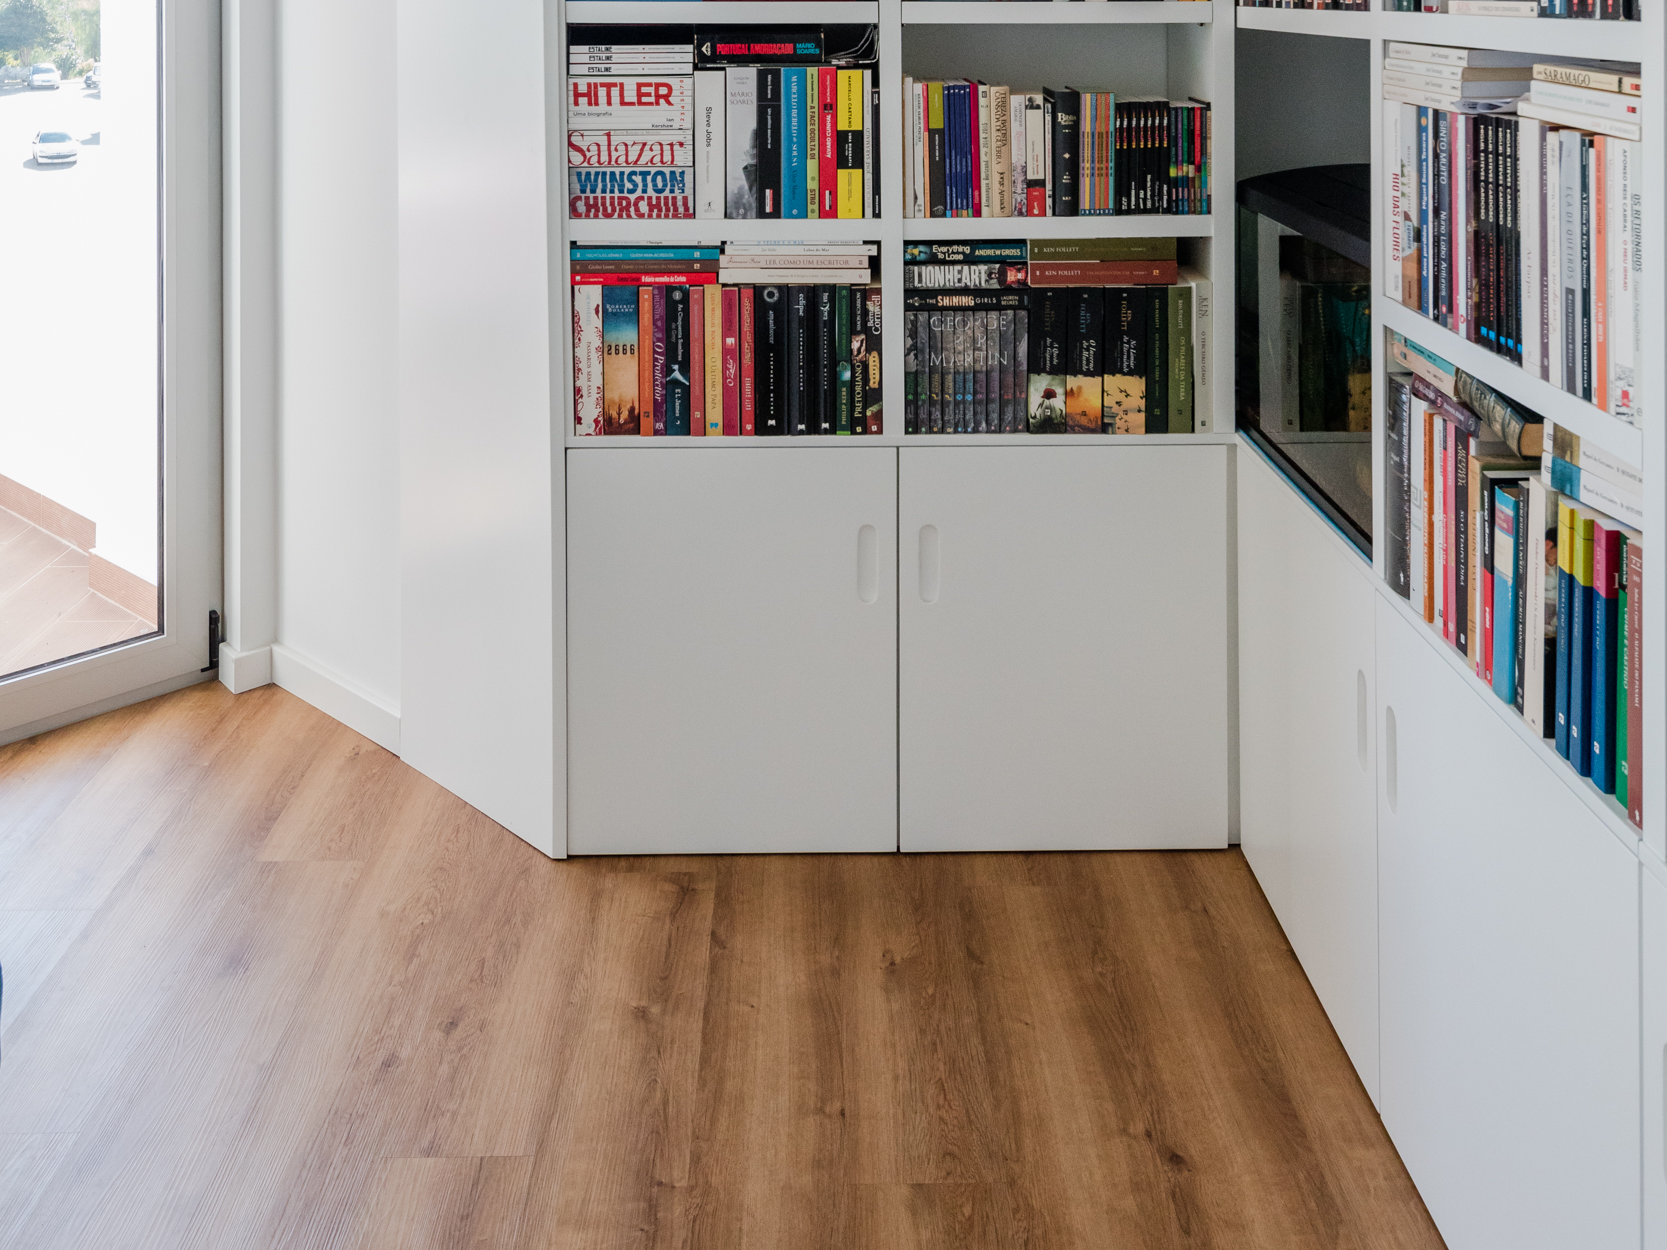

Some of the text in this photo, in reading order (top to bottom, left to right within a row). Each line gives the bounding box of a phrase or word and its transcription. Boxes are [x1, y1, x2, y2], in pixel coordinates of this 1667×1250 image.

[716, 43, 794, 55] PORTUGAL AMORDAÇADO
[1543, 68, 1590, 86] SARAMAGO
[572, 82, 674, 107] HITLER
[995, 125, 1001, 135] DE
[568, 131, 684, 166] Salazar
[576, 170, 686, 194] WINSTON
[997, 171, 1006, 189] Jorge
[570, 195, 694, 219] CHURCHILL
[1392, 172, 1400, 262] RIO DAS FLORES
[1633, 193, 1642, 272] OS RETORNADOS
[933, 245, 970, 254] Everything
[914, 266, 988, 287] LIONHEART
[794, 294, 806, 316] eclipse
[938, 296, 974, 307] SHINING
[872, 295, 881, 334] Cornwell
[930, 316, 1007, 331] GEORGE
[607, 344, 635, 355] 2666
[930, 352, 1008, 366] MARTIN
[654, 342, 665, 402] O Protector
